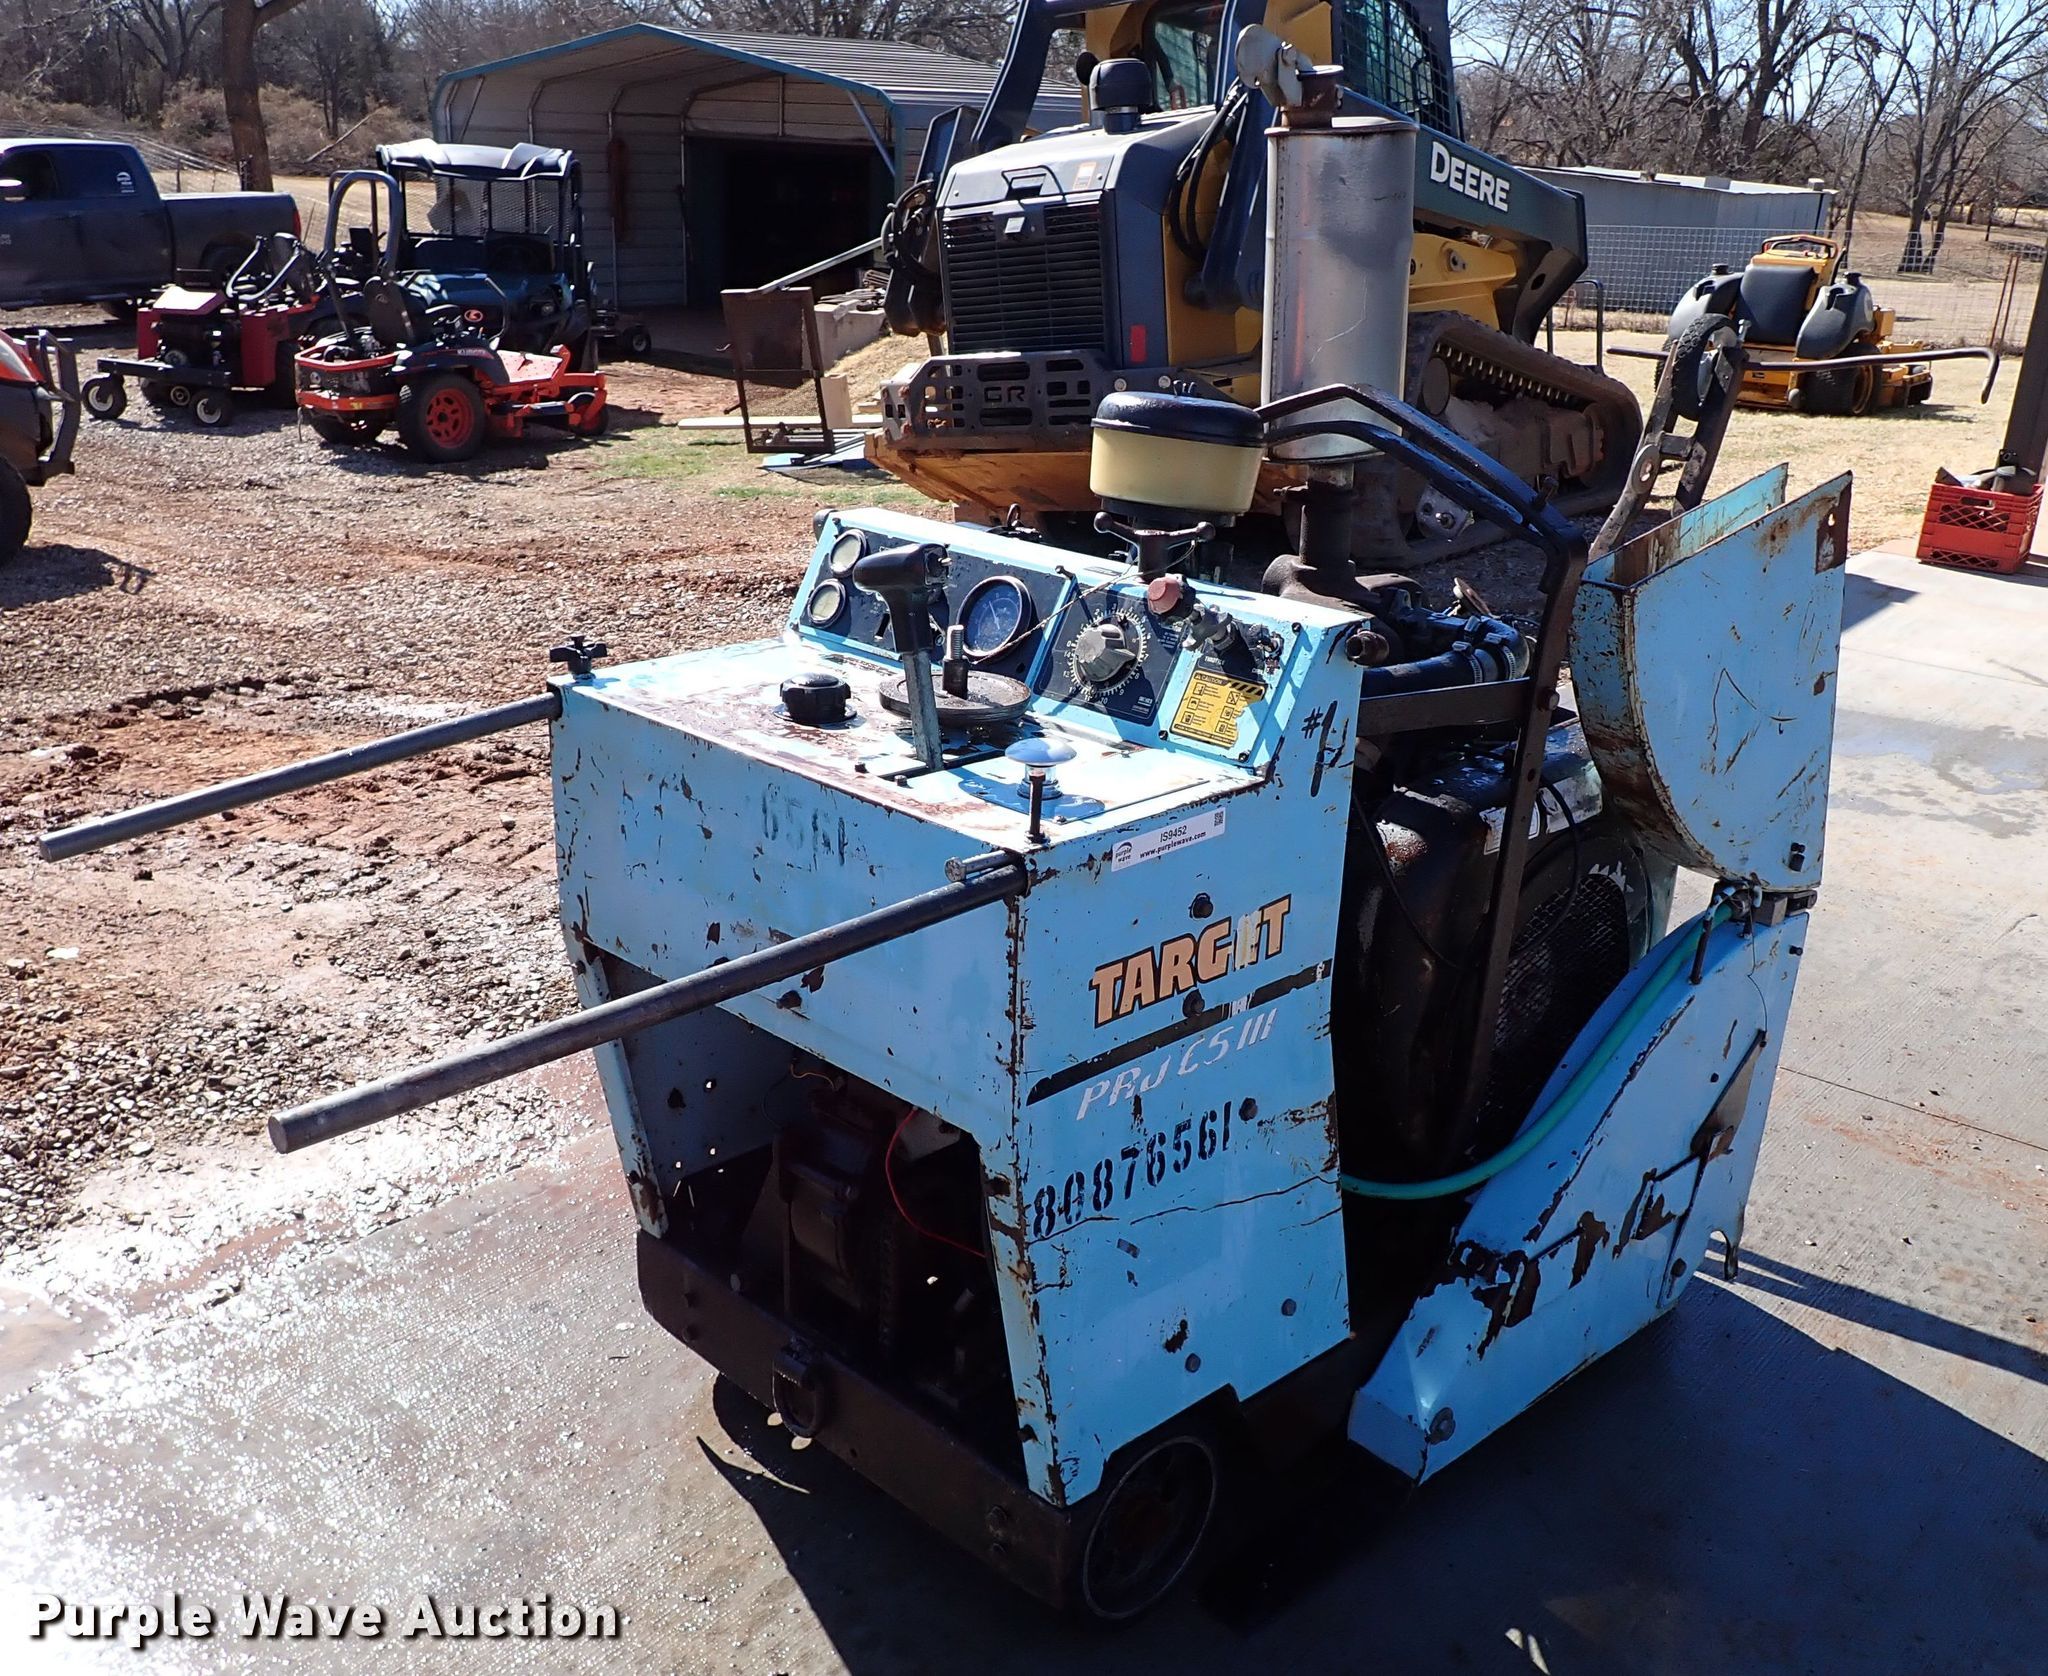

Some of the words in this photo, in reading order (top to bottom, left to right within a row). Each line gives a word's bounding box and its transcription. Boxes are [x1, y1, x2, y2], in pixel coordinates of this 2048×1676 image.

[1430, 141, 1510, 212] DEERE
[984, 386, 1025, 402] GR
[1160, 825, 1187, 843] IS9452
[1115, 847, 1132, 858] purple
[1140, 831, 1206, 859] www.purplewave.com
[1118, 854, 1131, 862] wave
[1089, 894, 1291, 1029] TARGT
